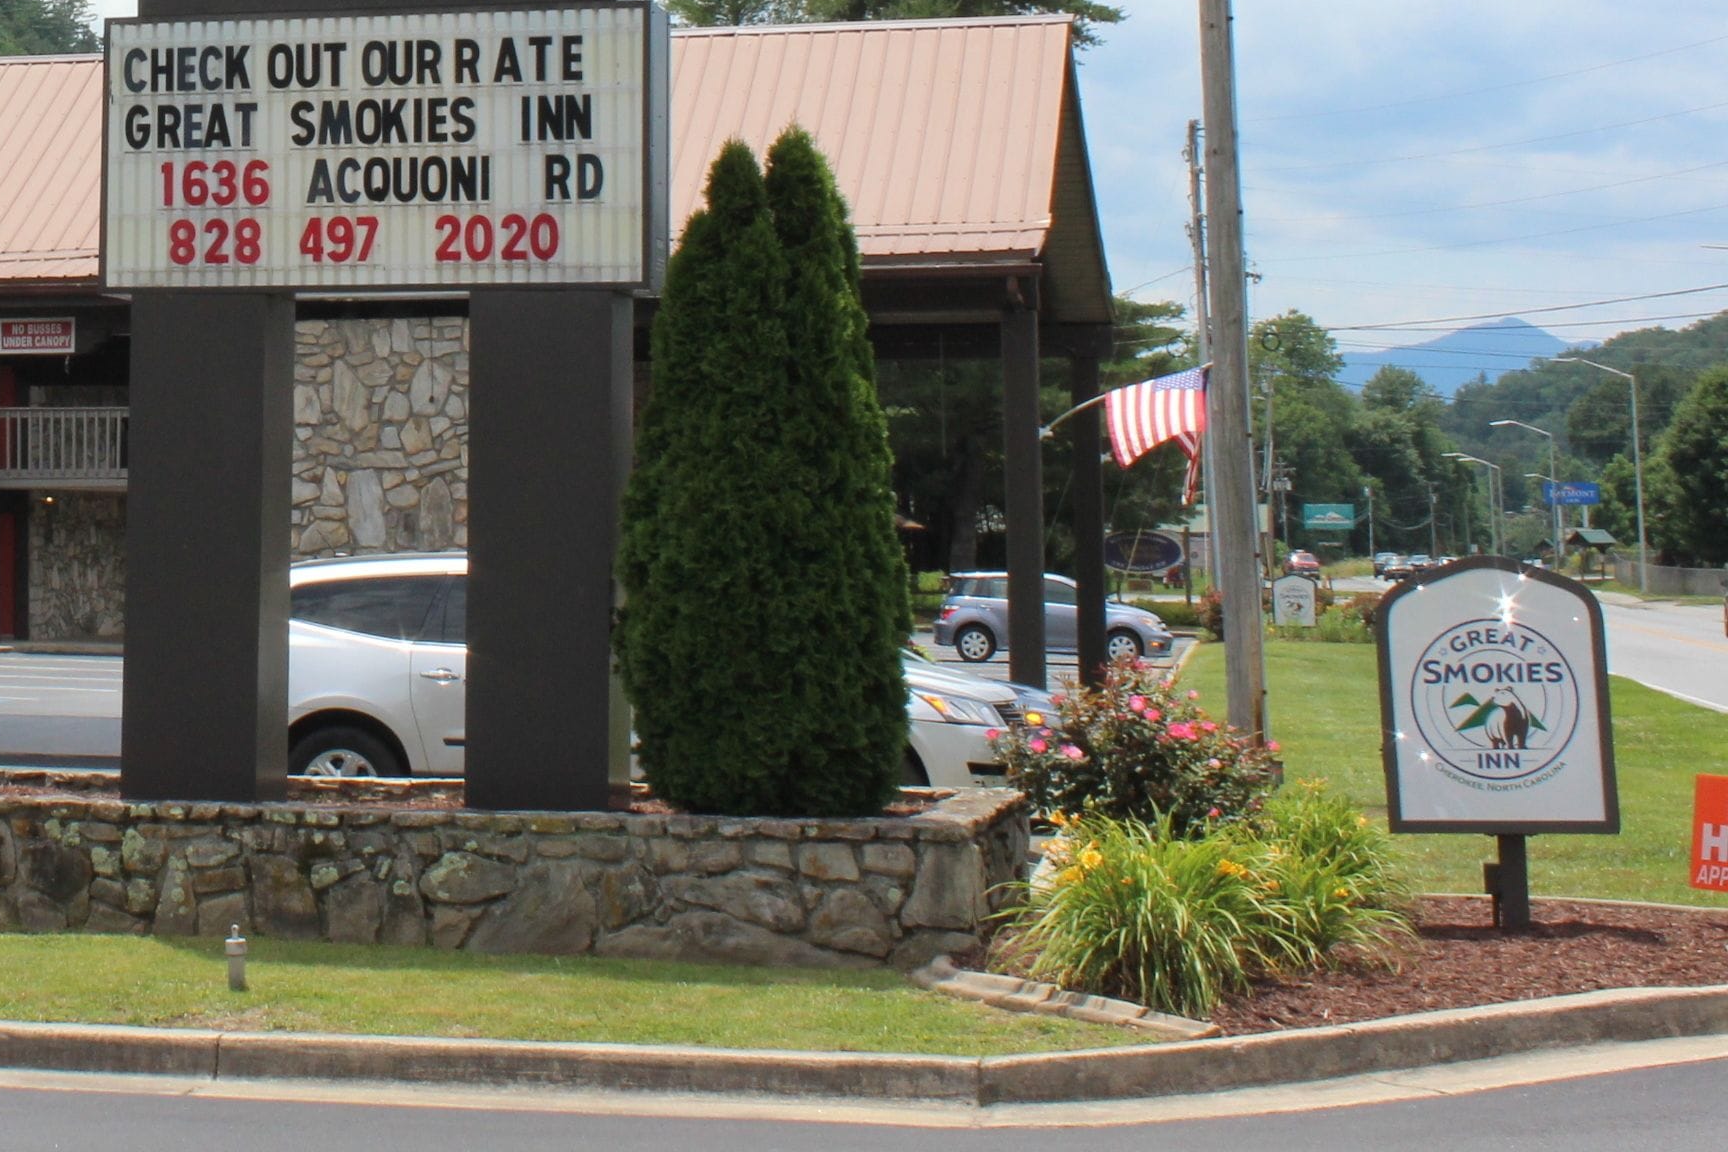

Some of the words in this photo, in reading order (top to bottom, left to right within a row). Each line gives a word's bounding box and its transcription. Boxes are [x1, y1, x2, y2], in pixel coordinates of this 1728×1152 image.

[124, 45, 251, 93] CHECK
[268, 41, 347, 90] OUT
[362, 39, 442, 86] OUR
[455, 35, 584, 84] RATE
[125, 102, 258, 149] GREAT
[291, 96, 476, 147] SMOKIES
[521, 94, 592, 141] INN
[161, 159, 270, 206] 1636
[307, 154, 490, 204] ACQUONI
[545, 153, 604, 200] RD
[171, 217, 262, 265] 828
[299, 216, 379, 263] 497
[435, 213, 559, 262] 2020
[3, 336, 32, 348] UNDER
[34, 335, 71, 347] CANOPY
[12, 324, 25, 335] NO
[27, 323, 62, 335] BUSSES
[1449, 628, 1535, 653] GREAT
[1422, 659, 1564, 685] SMOKIES
[1477, 753, 1520, 769] INN
[1487, 783, 1522, 792] NORTH
[1522, 760, 1567, 788] CAROLINA
